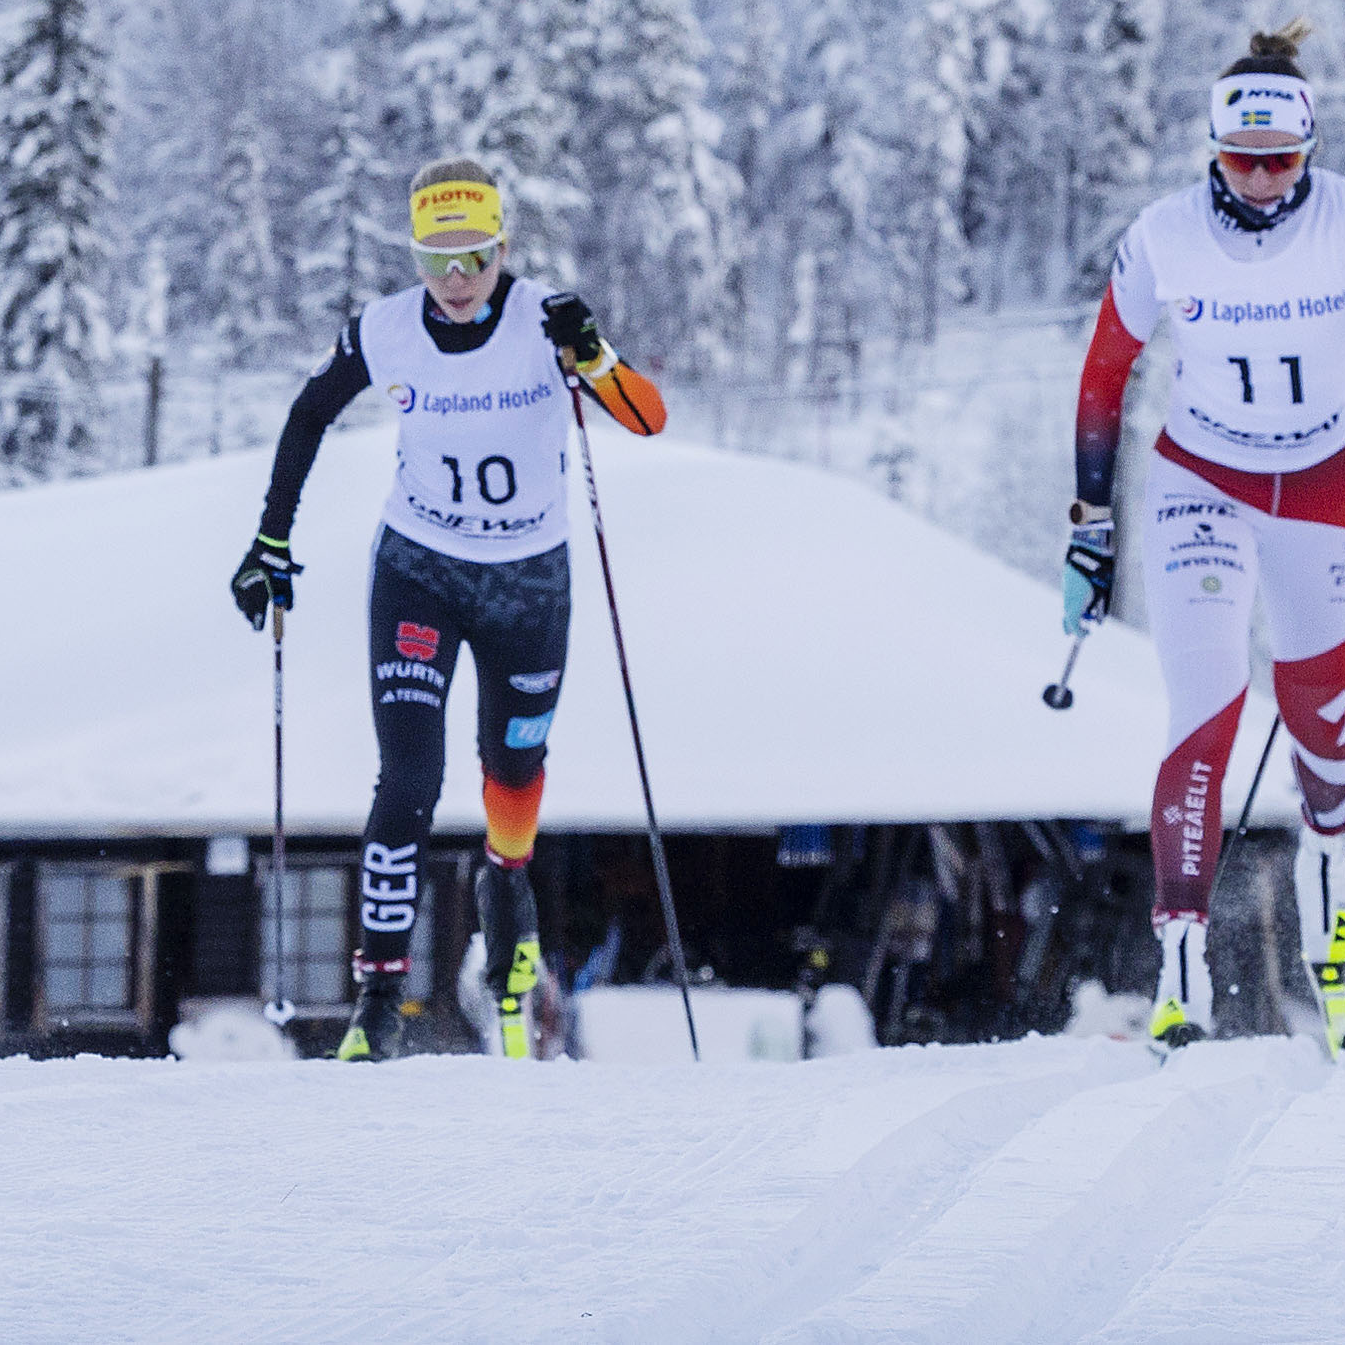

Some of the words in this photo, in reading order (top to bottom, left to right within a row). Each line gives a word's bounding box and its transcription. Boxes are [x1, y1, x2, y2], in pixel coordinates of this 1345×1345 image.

[1211, 300, 1292, 324] Lapland
[423, 392, 494, 415] Lapland
[498, 382, 552, 410] Hotels
[1227, 356, 1303, 404] 11
[441, 454, 517, 505] 10
[361, 841, 418, 932] GER
